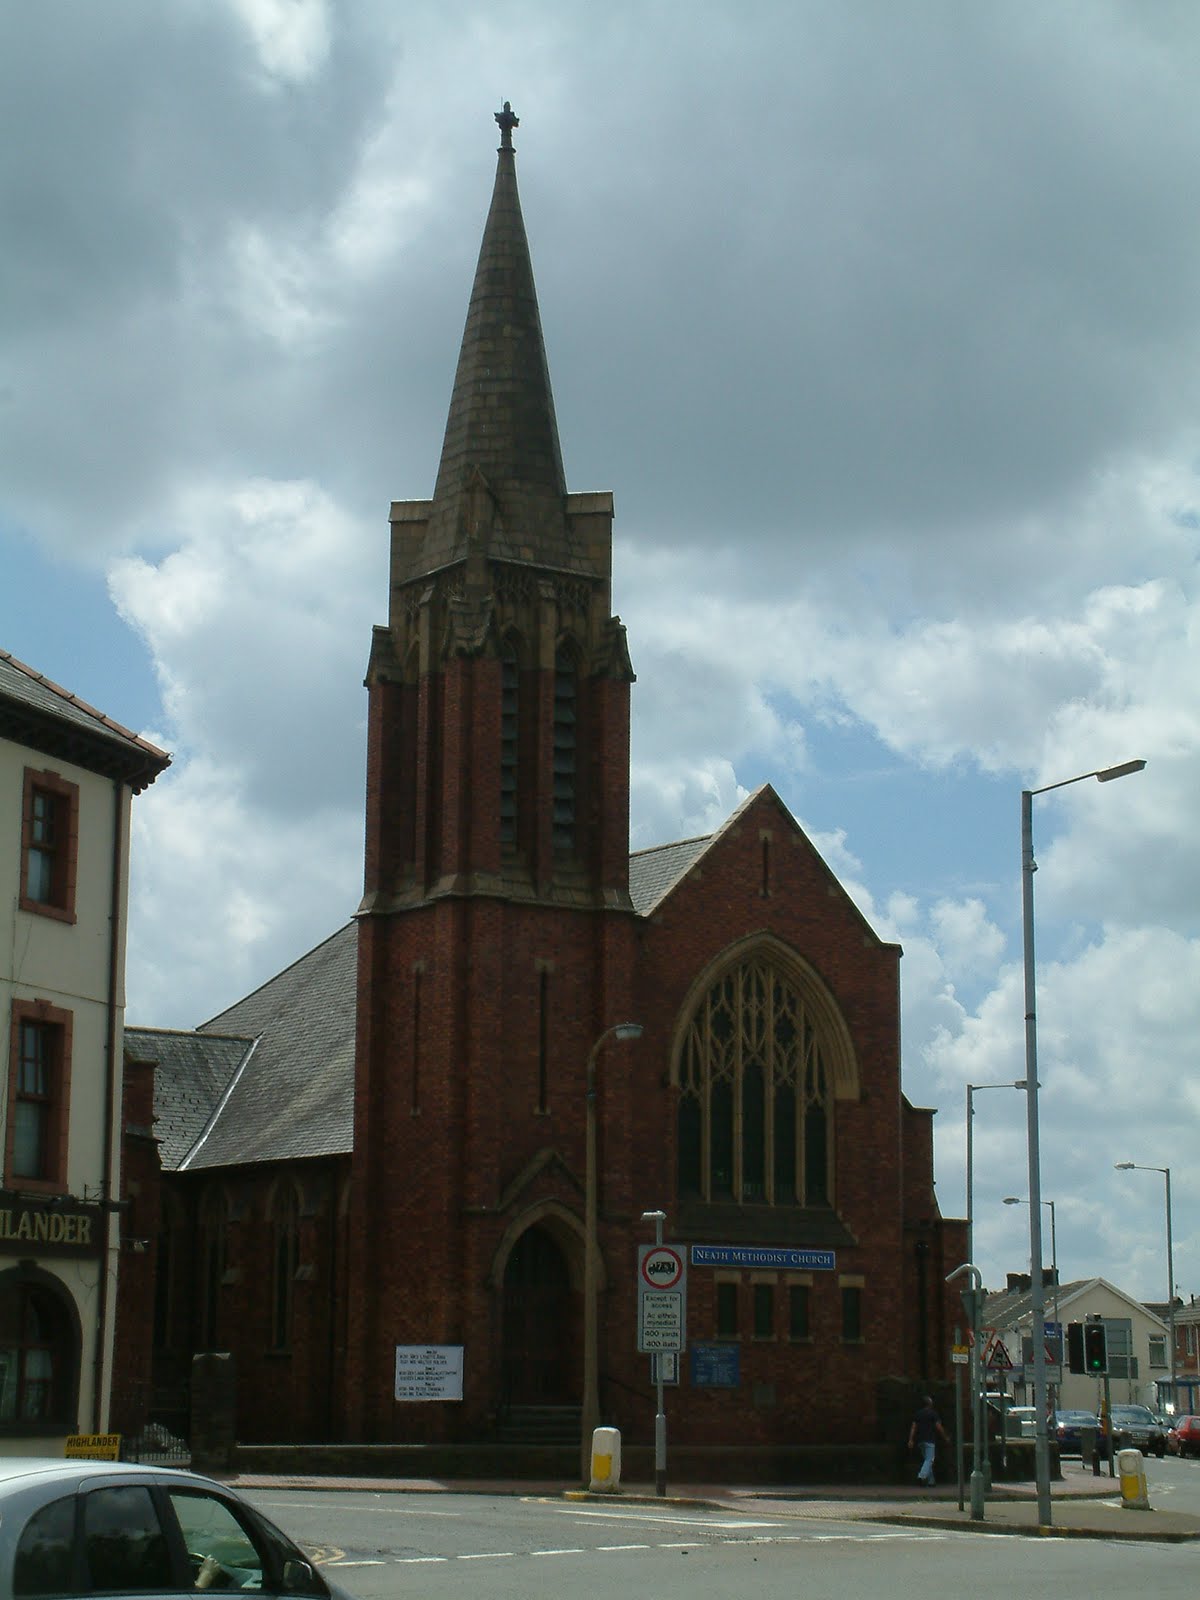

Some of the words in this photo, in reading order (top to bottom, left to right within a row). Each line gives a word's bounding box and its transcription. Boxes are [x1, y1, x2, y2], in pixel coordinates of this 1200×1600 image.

[696, 1250, 728, 1260] NEATH
[732, 1251, 787, 1263] METHODIST
[791, 1253, 831, 1264] CHURCH
[67, 1437, 118, 1447] HIGHLANDER
